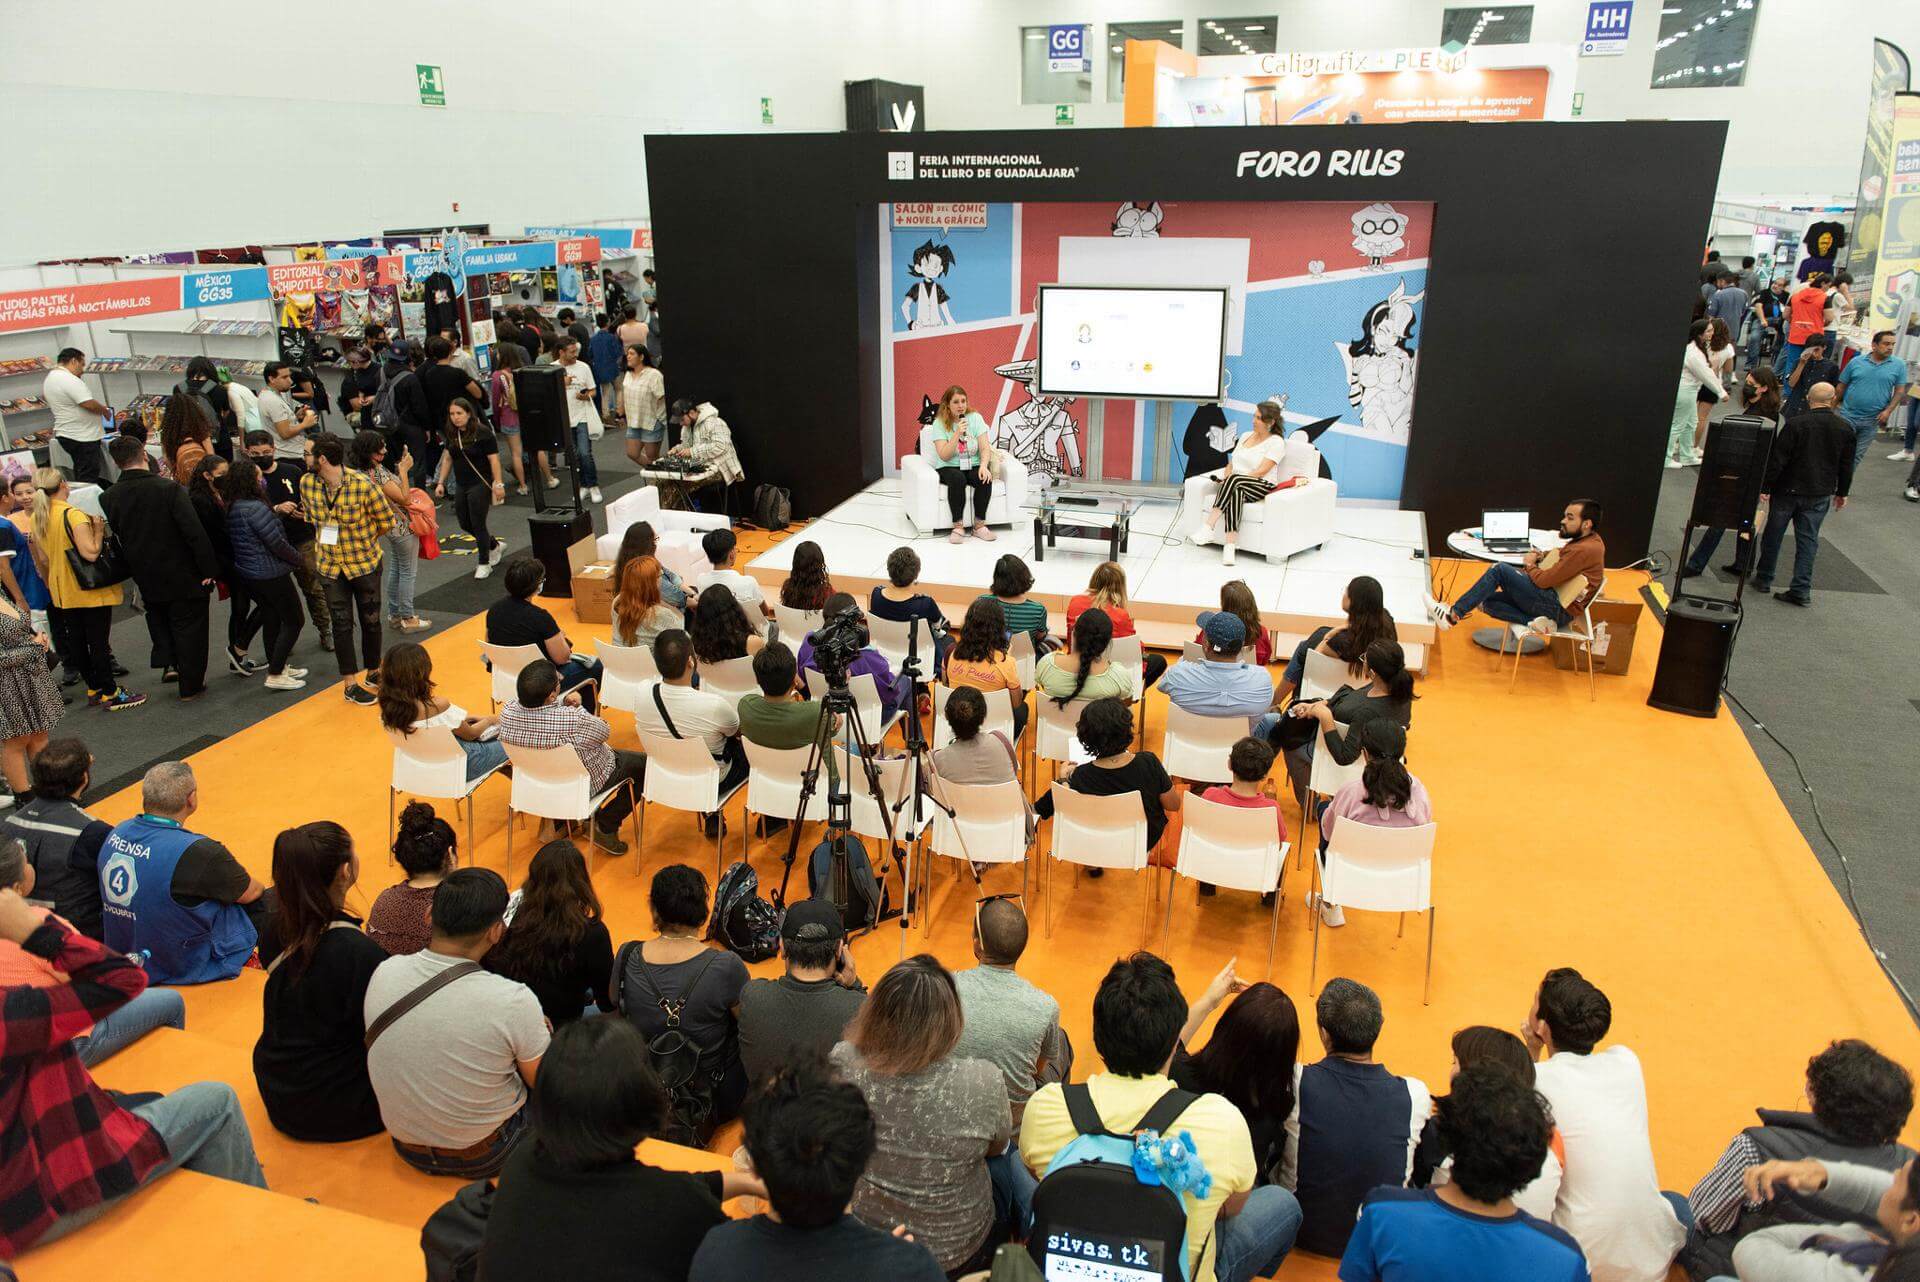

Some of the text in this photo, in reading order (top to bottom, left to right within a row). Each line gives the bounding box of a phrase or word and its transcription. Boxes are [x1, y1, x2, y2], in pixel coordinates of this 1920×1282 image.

[1592, 8, 1628, 29] HH
[1052, 29, 1080, 50] GG
[1261, 52, 1368, 77] Caligrafix
[1485, 96, 1534, 108] aprender
[919, 155, 1041, 165] FERIA INTERNACIONAL
[1236, 149, 1405, 178] FORO RIUS
[919, 168, 939, 178] DEL
[942, 168, 974, 178] LIBRO
[977, 168, 991, 178] DE
[906, 216, 942, 224] NOVELA
[944, 214, 985, 224] GRÁFICA
[465, 253, 494, 266] FAMILIA
[273, 265, 323, 281] EDITORIAL
[195, 274, 232, 289] MÉXICO
[276, 278, 324, 292] CHIPOTLE
[31, 294, 68, 307] PALTIK
[198, 286, 233, 303] GG35
[48, 303, 77, 316] PARA
[78, 296, 151, 314] NOCTÁMBULOS
[108, 834, 151, 859] PRENSA
[112, 870, 124, 892] 4
